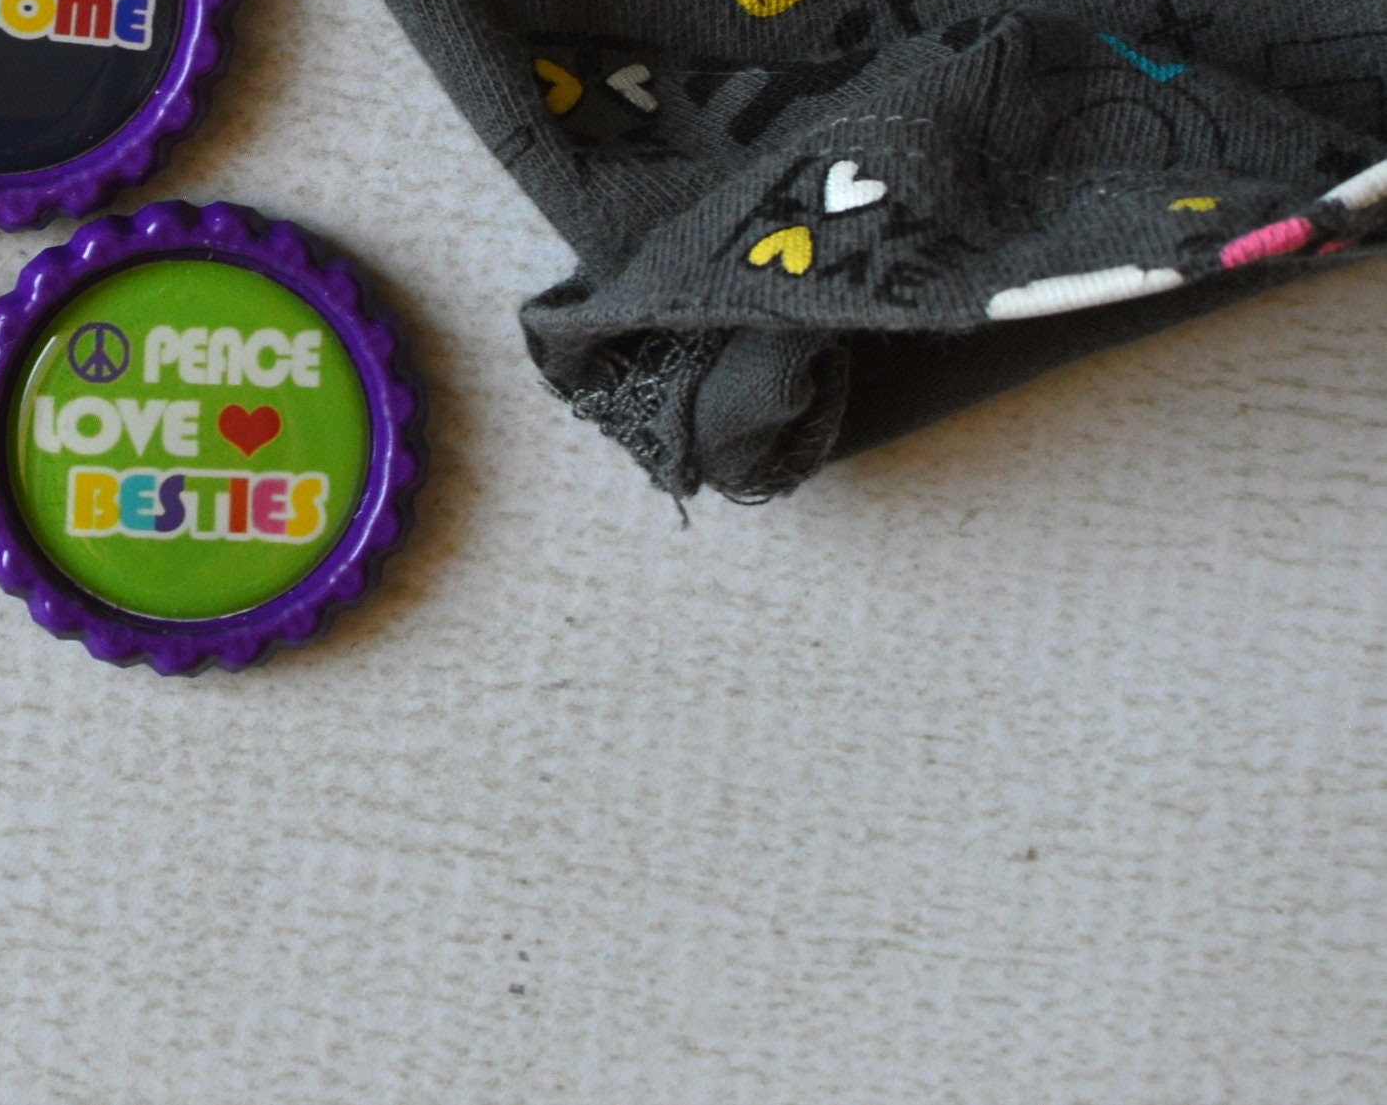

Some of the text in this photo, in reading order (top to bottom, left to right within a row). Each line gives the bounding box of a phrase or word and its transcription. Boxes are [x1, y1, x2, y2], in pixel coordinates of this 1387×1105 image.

[143, 324, 323, 388] PEACE
[33, 396, 201, 457] LOVE
[69, 469, 326, 540] BESTIES
